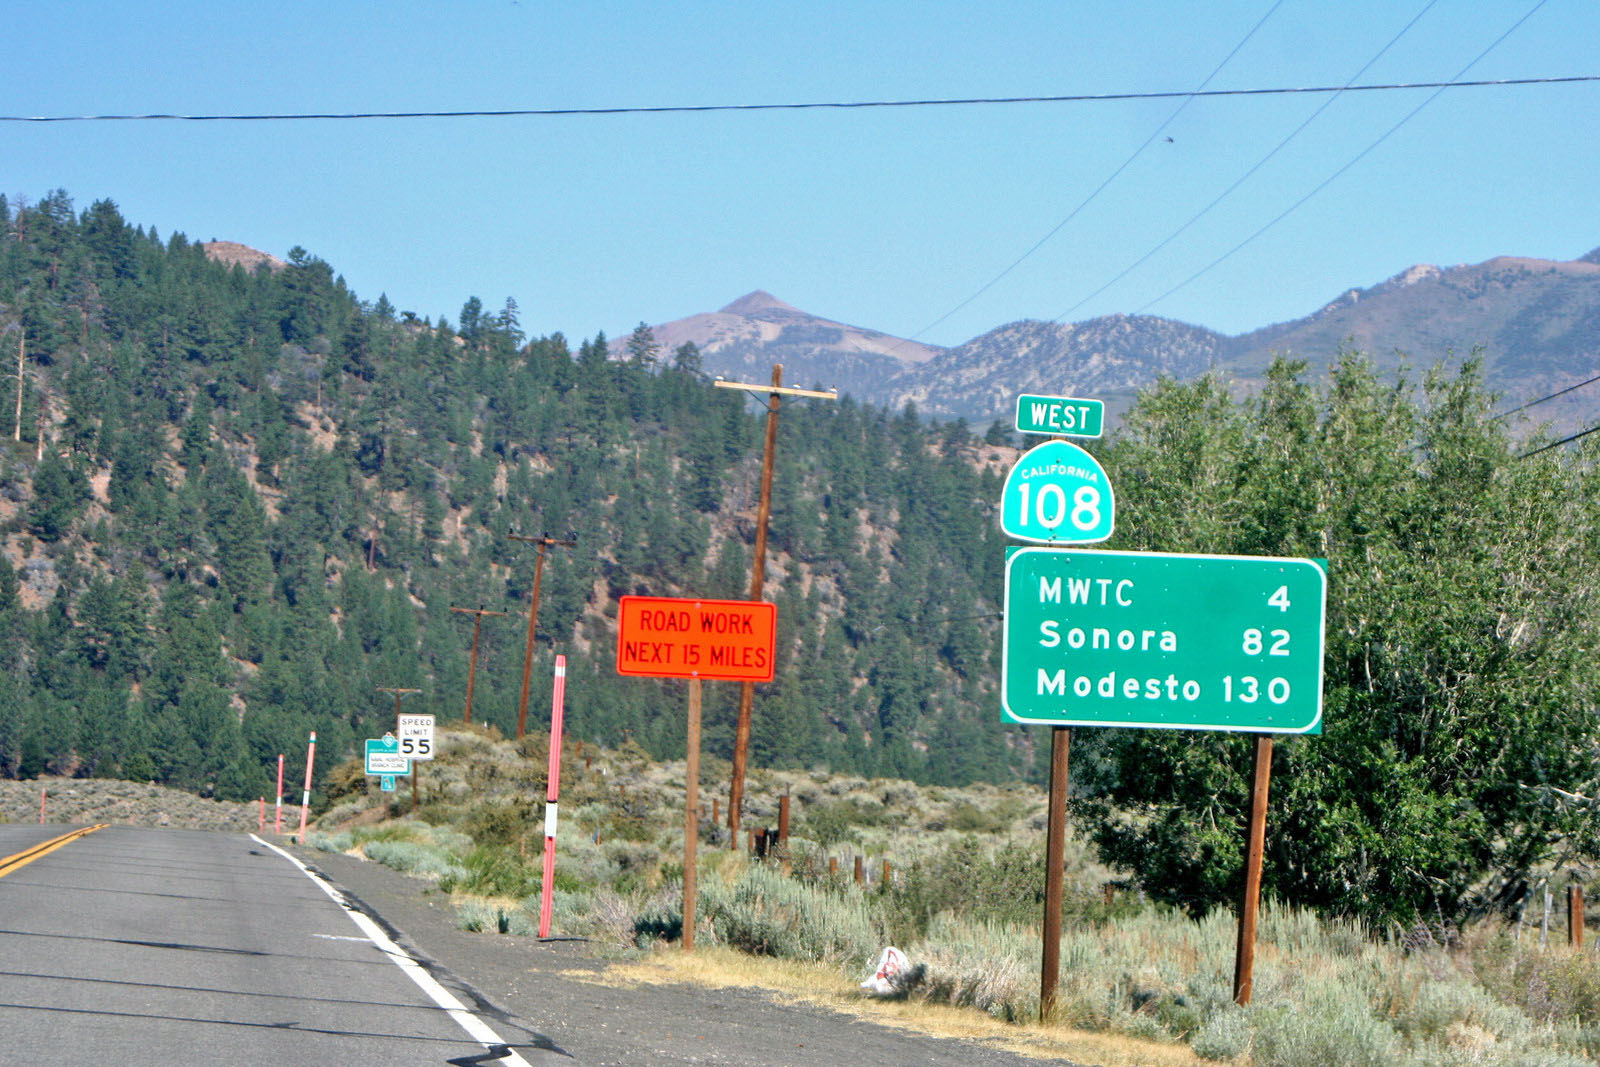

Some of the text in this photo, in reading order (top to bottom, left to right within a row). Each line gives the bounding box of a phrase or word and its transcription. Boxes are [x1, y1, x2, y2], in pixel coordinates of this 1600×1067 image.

[1031, 402, 1090, 430] WEST
[1021, 464, 1098, 483] CALIFORNIA
[1018, 482, 1101, 531] 108
[1039, 576, 1134, 607] MWTC
[1267, 585, 1291, 612] 4
[640, 610, 753, 635] ROAD WORK
[1039, 620, 1177, 652] Sonora
[625, 641, 767, 669] NEXT 15 MILES
[1242, 628, 1291, 656] 82
[1036, 668, 1201, 701] Modesto
[1222, 675, 1291, 704] 130
[401, 718, 432, 726] SPEED
[402, 738, 431, 755] 55
